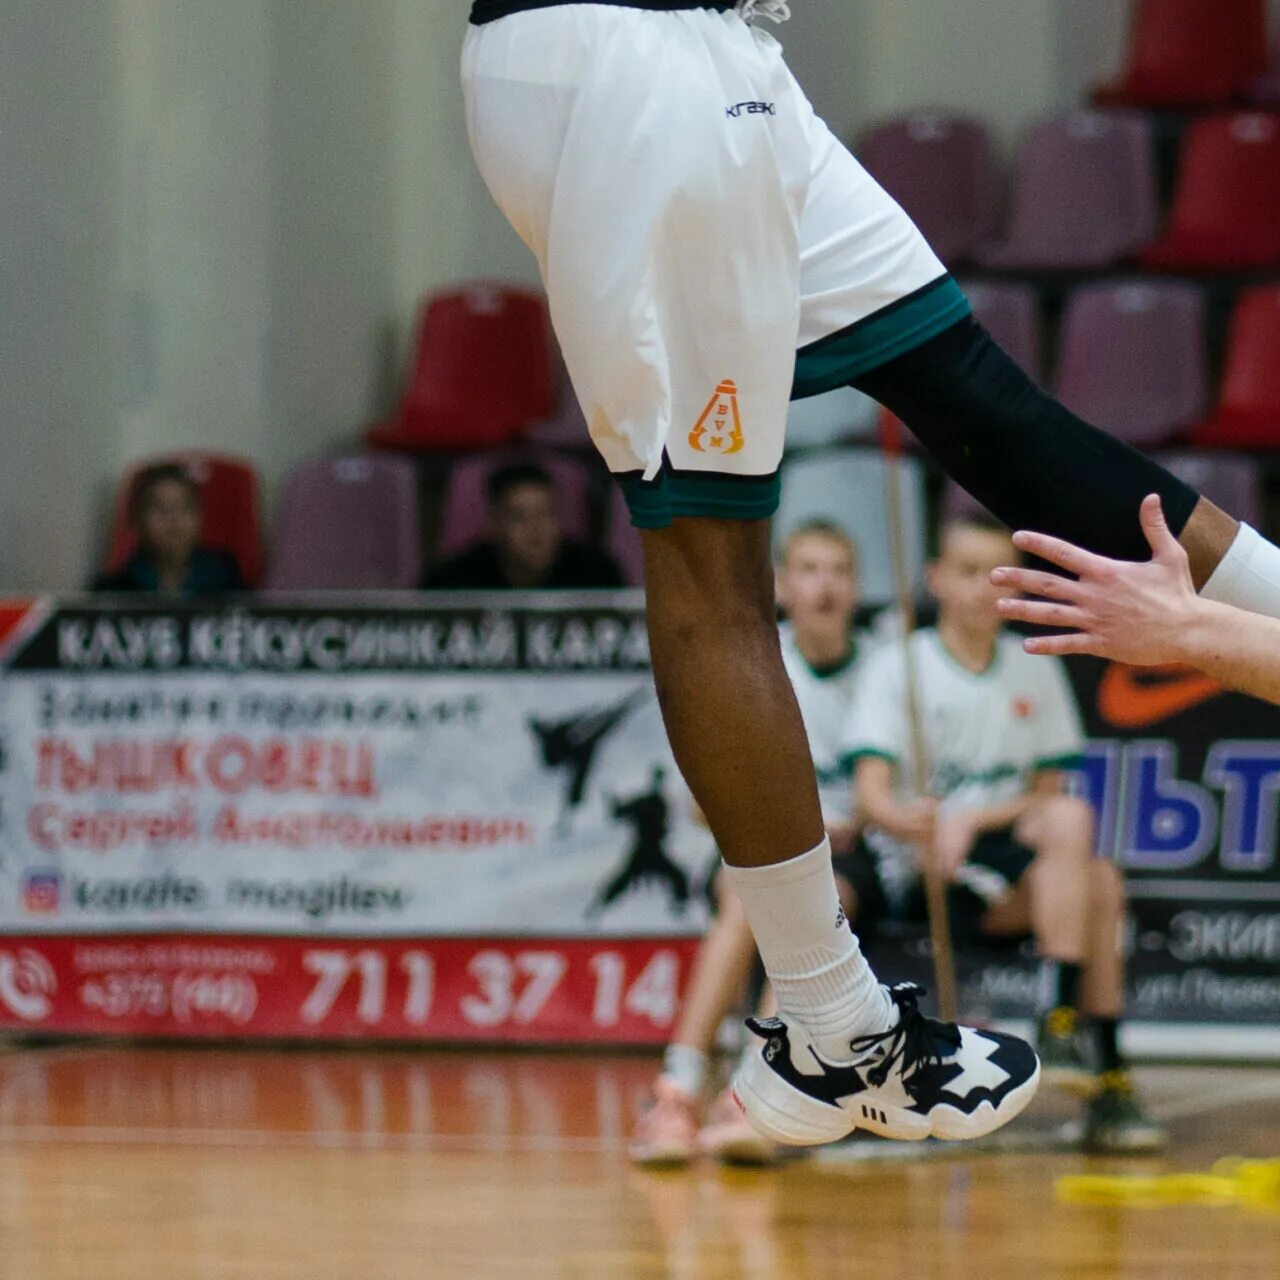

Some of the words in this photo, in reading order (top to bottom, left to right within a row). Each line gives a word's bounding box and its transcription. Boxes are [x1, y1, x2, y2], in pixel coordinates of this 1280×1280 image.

[58, 618, 182, 666] КЛУБ
[524, 617, 652, 667] КАРА
[303, 948, 435, 1024] 711
[460, 948, 568, 1025] 37
[588, 949, 682, 1026] 14
